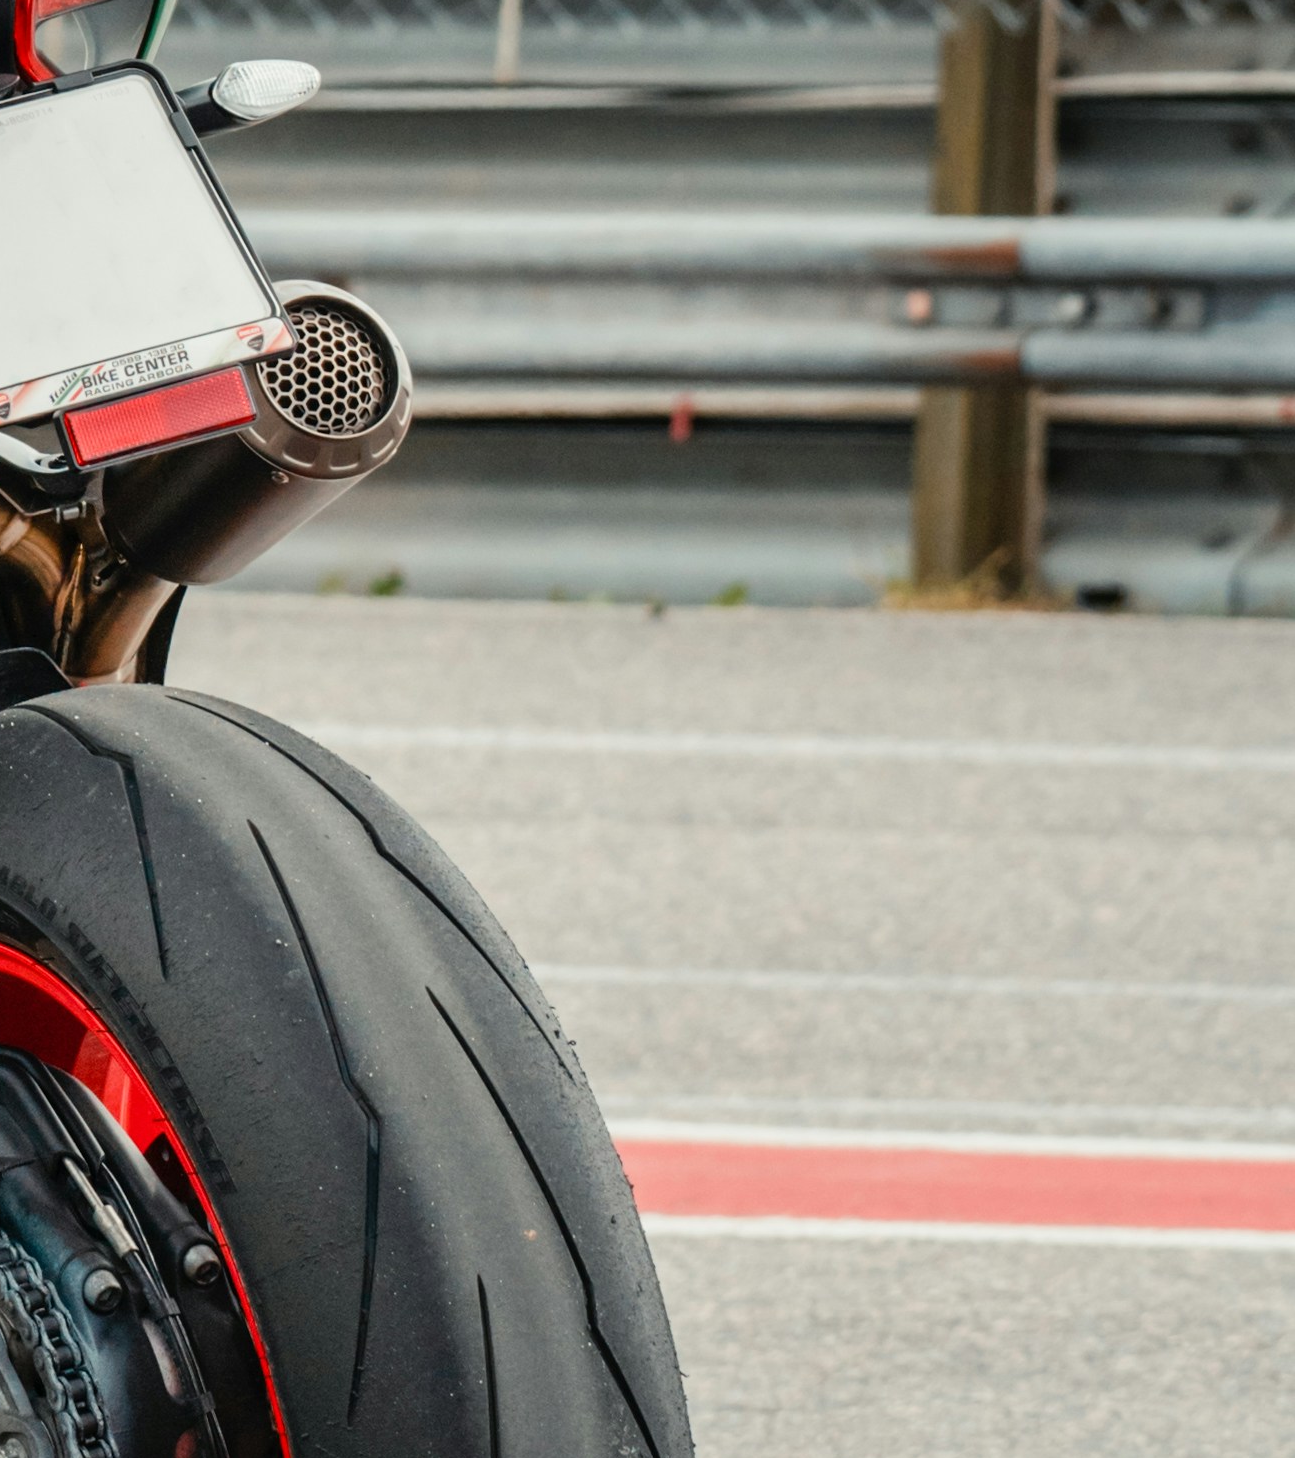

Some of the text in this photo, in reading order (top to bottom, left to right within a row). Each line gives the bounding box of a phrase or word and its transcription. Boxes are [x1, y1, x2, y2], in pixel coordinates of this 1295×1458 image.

[81, 350, 190, 389] BIKE CENTER
[84, 363, 193, 398] RACING ARBOGA
[67, 922, 238, 1195] SUPERCORSA
